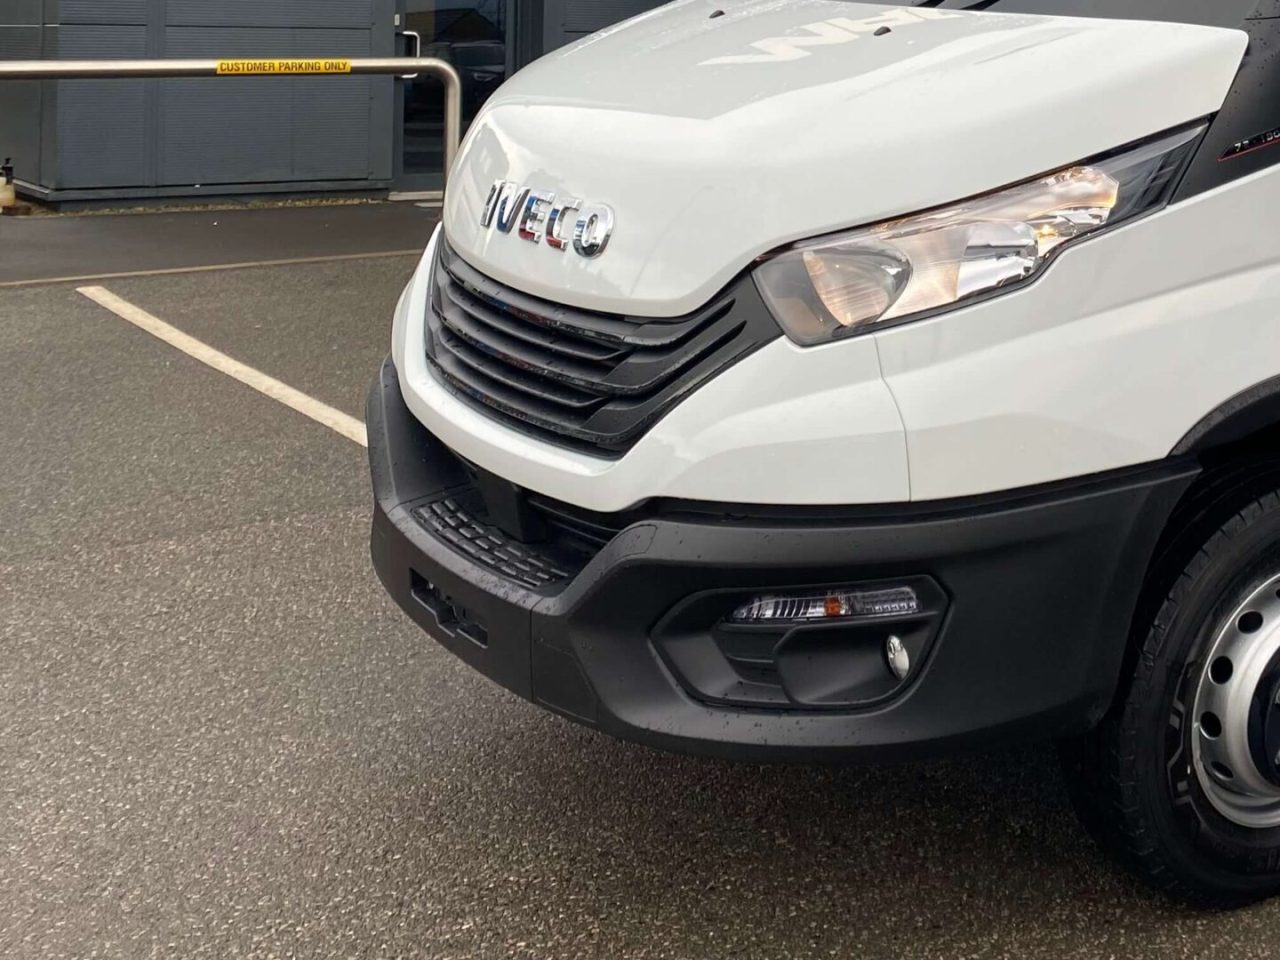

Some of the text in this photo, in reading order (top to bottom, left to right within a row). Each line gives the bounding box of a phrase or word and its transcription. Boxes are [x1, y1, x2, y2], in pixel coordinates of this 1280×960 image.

[220, 61, 347, 72] CUSTOMER PARKING ONLY
[480, 178, 616, 260] IVECO
